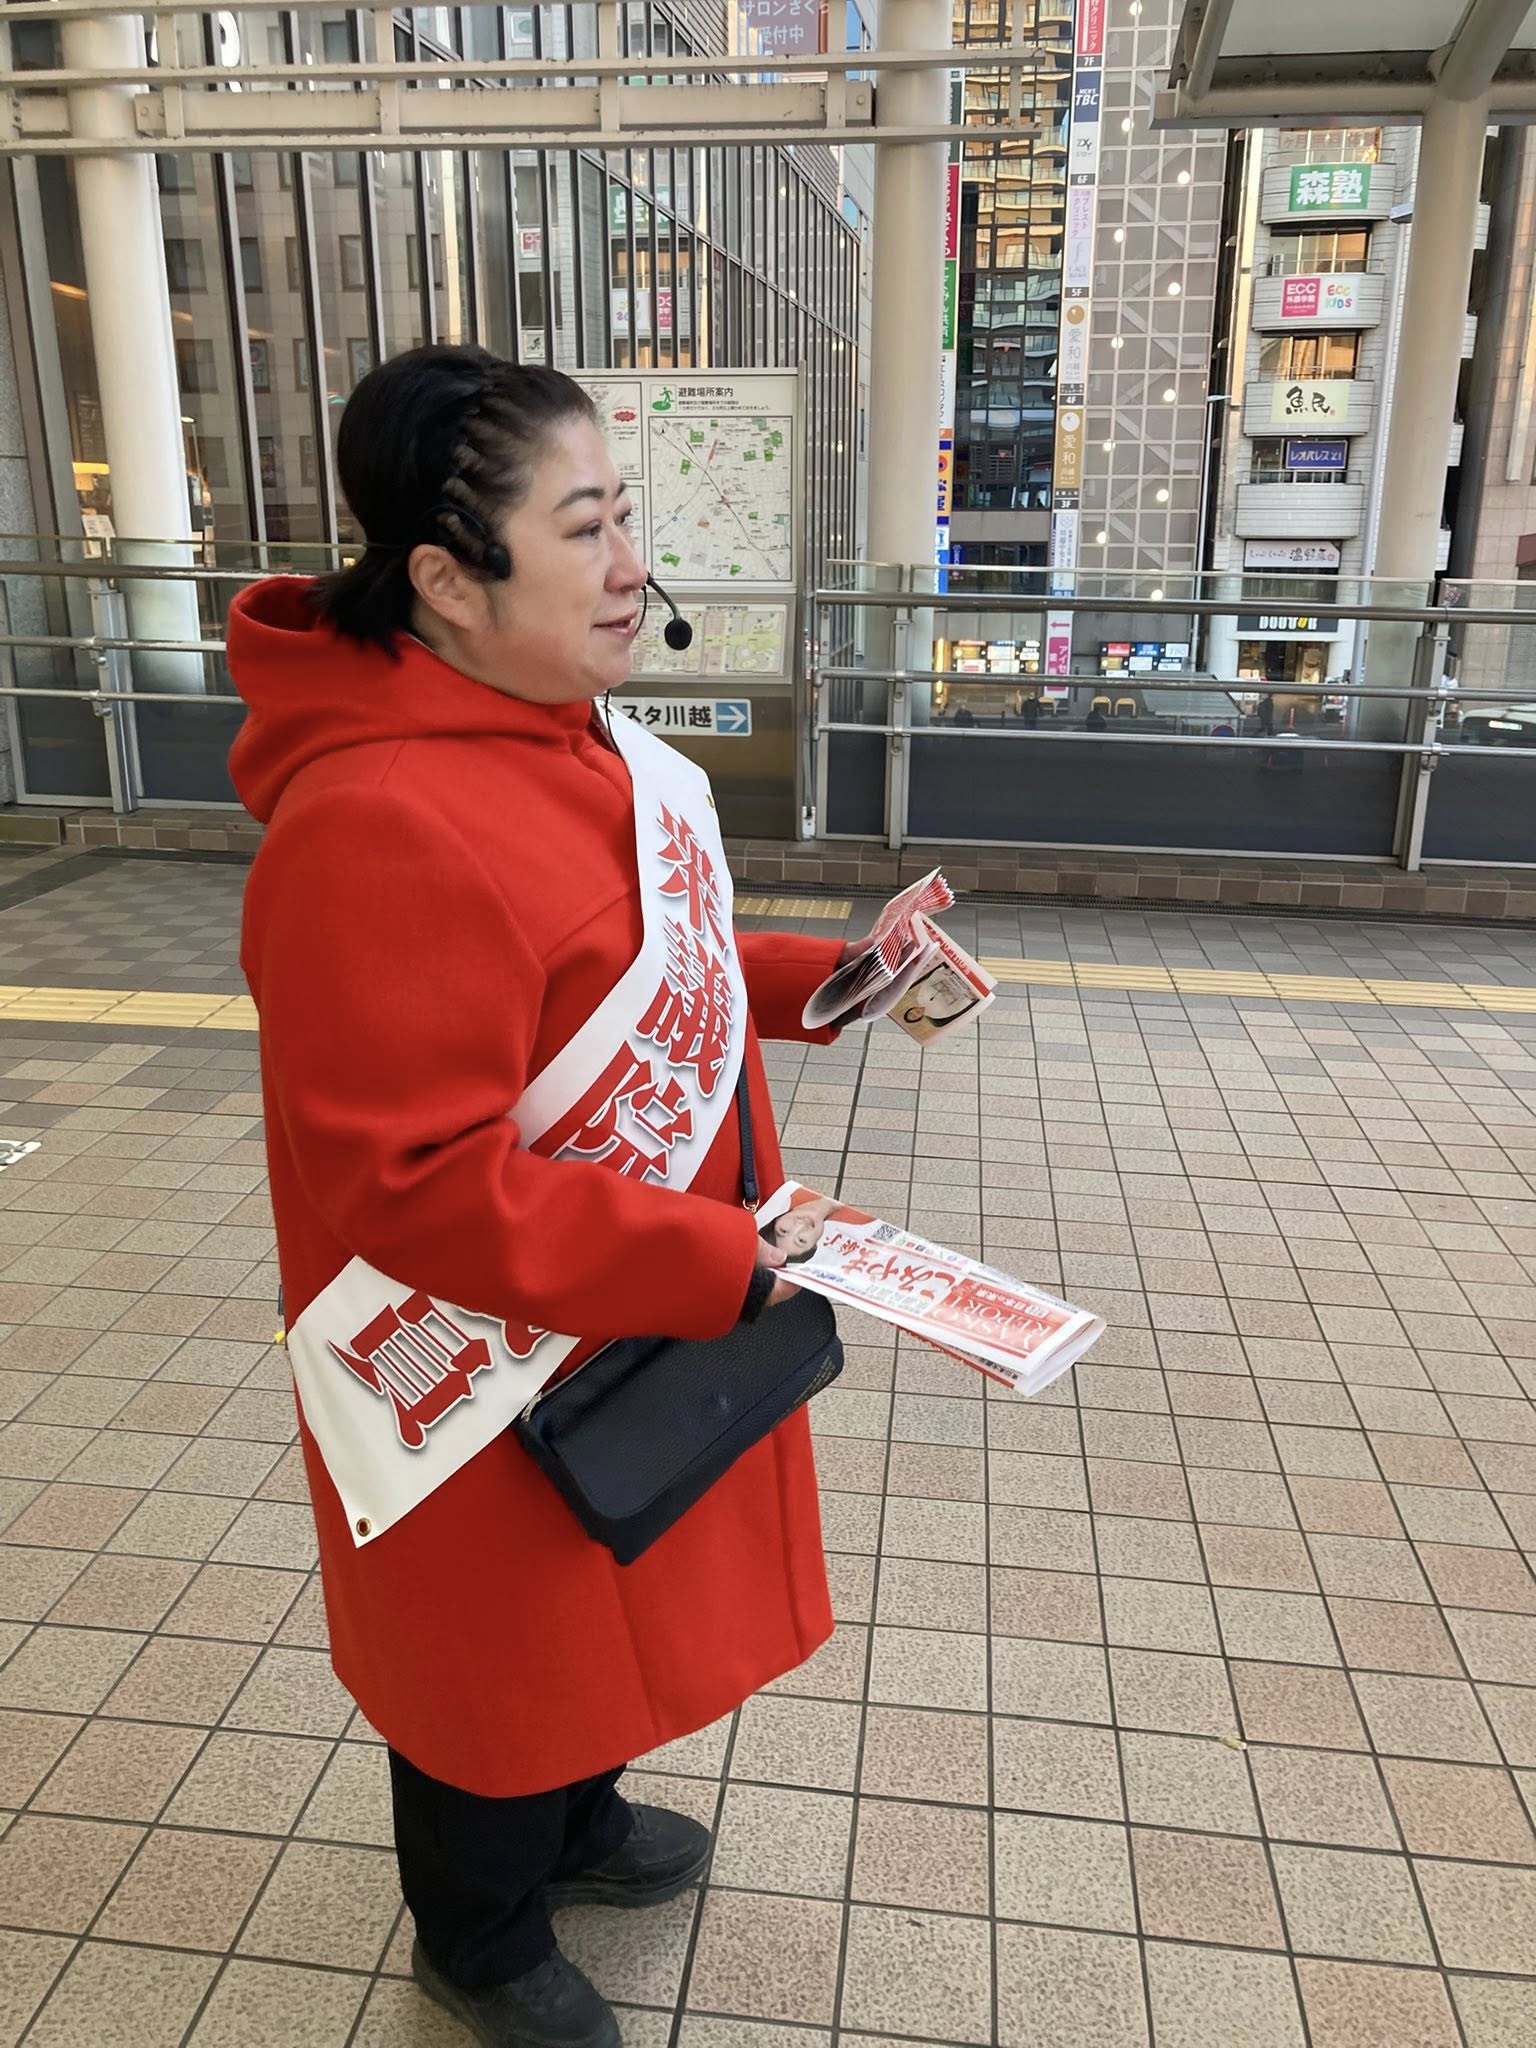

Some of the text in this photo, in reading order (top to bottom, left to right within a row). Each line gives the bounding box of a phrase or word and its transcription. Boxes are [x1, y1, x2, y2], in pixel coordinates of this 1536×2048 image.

[1083, 57, 1095, 66] 7F
[1075, 94, 1099, 106] TBC
[1077, 175, 1089, 184] 6F
[1296, 169, 1363, 205] 森塾
[1072, 288, 1082, 297] 5F
[1286, 282, 1317, 296] ECC
[1327, 285, 1350, 297] ECC
[678, 387, 734, 397] 避難場所案内
[1066, 396, 1077, 404] 4F
[1285, 386, 1331, 415] 魚民
[1061, 434, 1077, 466] 愛和
[1060, 500, 1072, 508] 3F
[943, 1296, 1053, 1338] REPORT
